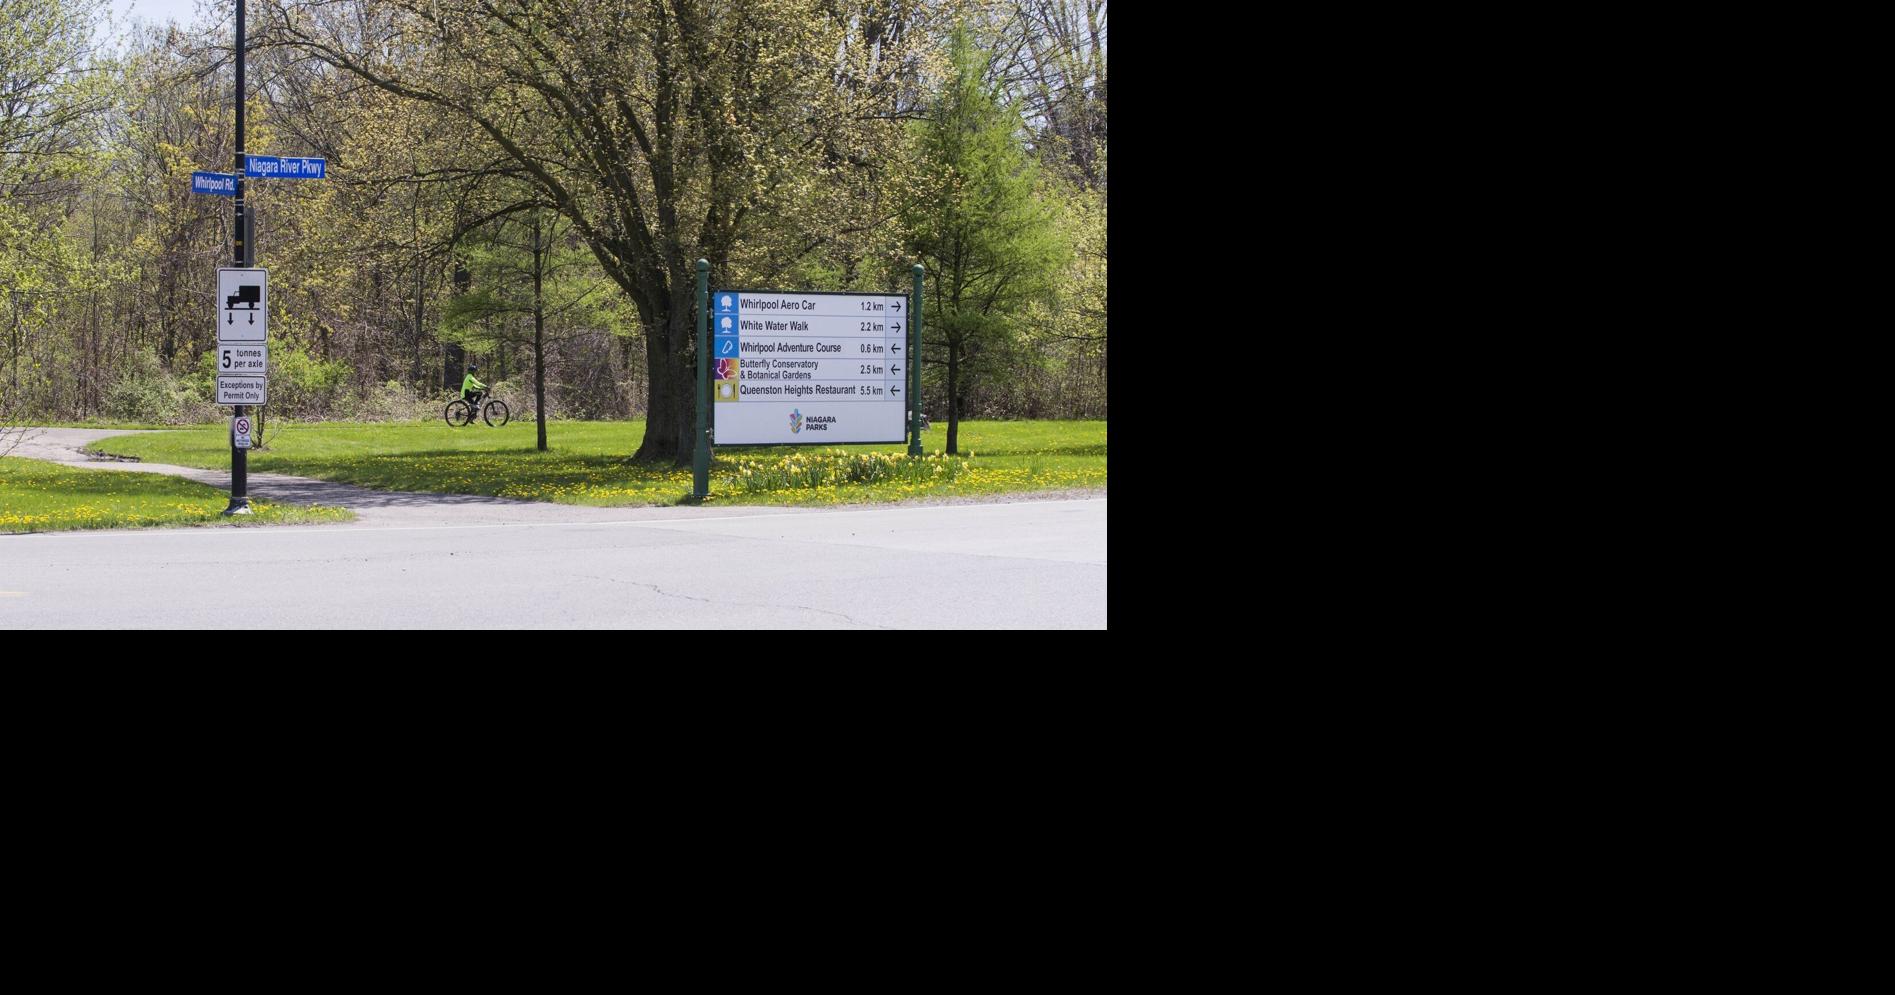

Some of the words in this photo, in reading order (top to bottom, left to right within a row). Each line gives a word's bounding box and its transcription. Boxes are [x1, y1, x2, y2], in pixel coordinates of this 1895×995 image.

[250, 158, 278, 176] Niagara
[280, 160, 299, 173] River
[302, 160, 321, 177] Pkwy
[195, 176, 223, 192] Whirlpool
[225, 178, 235, 190] Rd.
[740, 299, 779, 310] Whirlpool
[781, 300, 799, 310] Aero
[802, 301, 816, 310] Car
[861, 302, 871, 310] 1.2
[873, 302, 883, 311] km
[740, 321, 763, 330] White
[765, 321, 787, 330] Water
[789, 322, 808, 331] Walk
[860, 323, 871, 331] 2.2
[873, 323, 883, 331] km
[740, 343, 776, 353] Whirlpool
[778, 343, 814, 352] Adventure
[816, 344, 841, 352] Course
[860, 345, 871, 353] 0.6
[873, 345, 883, 353] km
[222, 350, 231, 368] 5
[234, 361, 245, 369] per
[740, 360, 770, 370] Butterfly
[772, 360, 818, 370] Conservatory
[860, 365, 871, 374] 2.5
[873, 365, 883, 374] km
[747, 371, 780, 379] Botanical
[220, 381, 254, 390] Exceptions
[256, 381, 263, 390] by
[740, 385, 782, 394] Queenston
[784, 385, 813, 396] Heights
[816, 386, 855, 394] Restaurant
[861, 386, 871, 395] 5.5
[872, 386, 883, 395] km
[246, 391, 259, 400] Only
